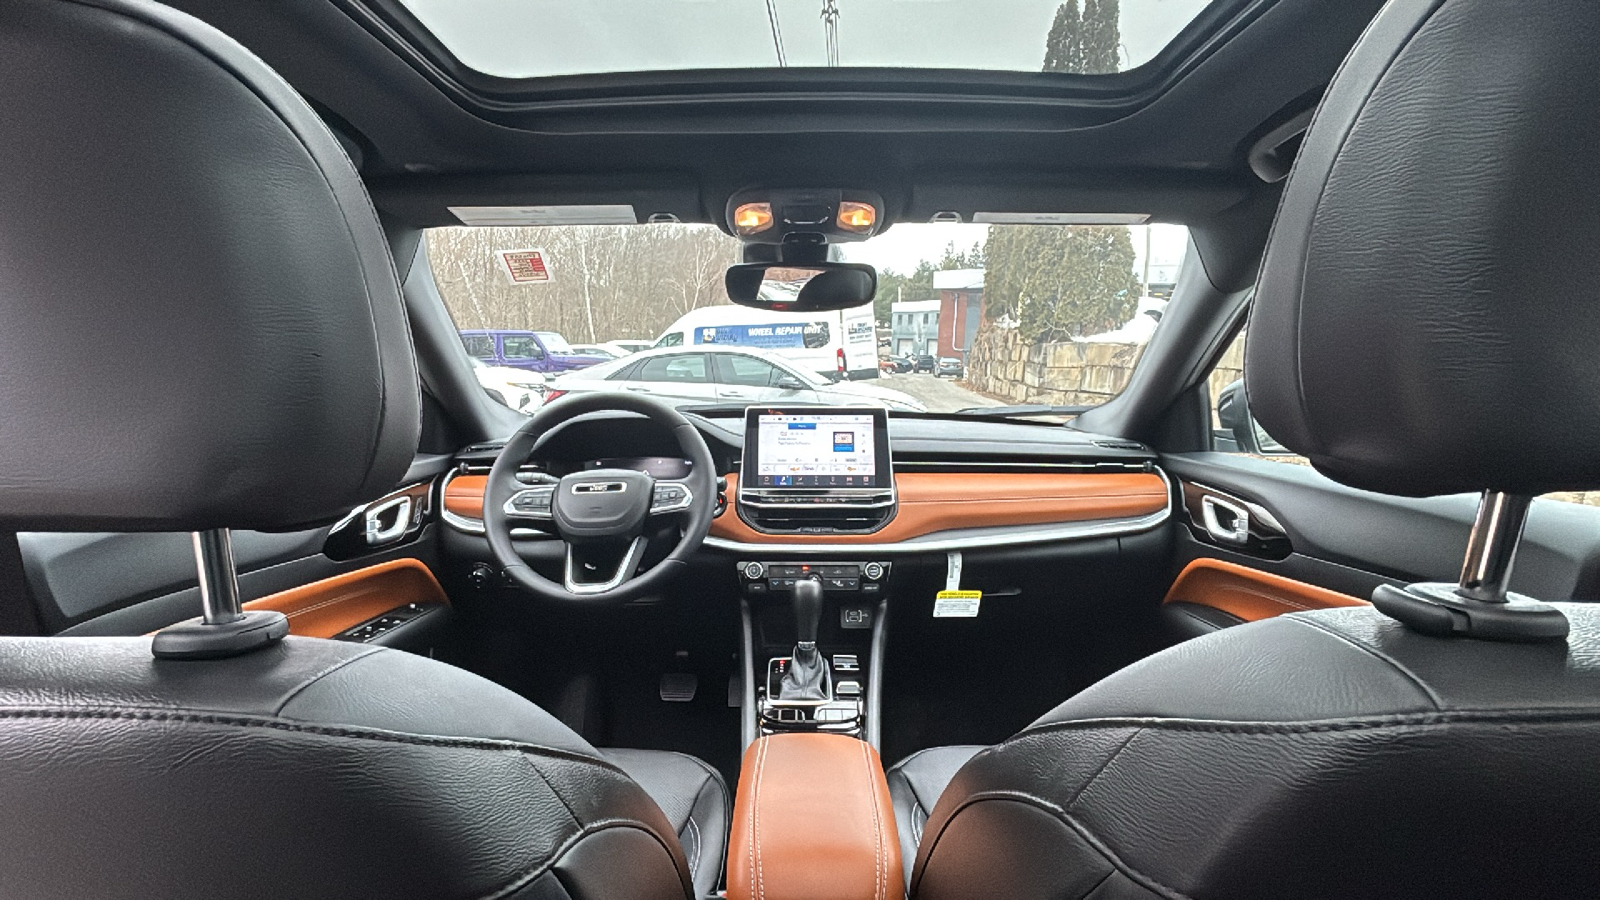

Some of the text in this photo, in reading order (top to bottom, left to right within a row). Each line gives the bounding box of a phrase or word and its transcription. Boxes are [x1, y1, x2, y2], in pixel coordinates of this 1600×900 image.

[748, 325, 821, 336] WHEEL REPAIR UNIT
